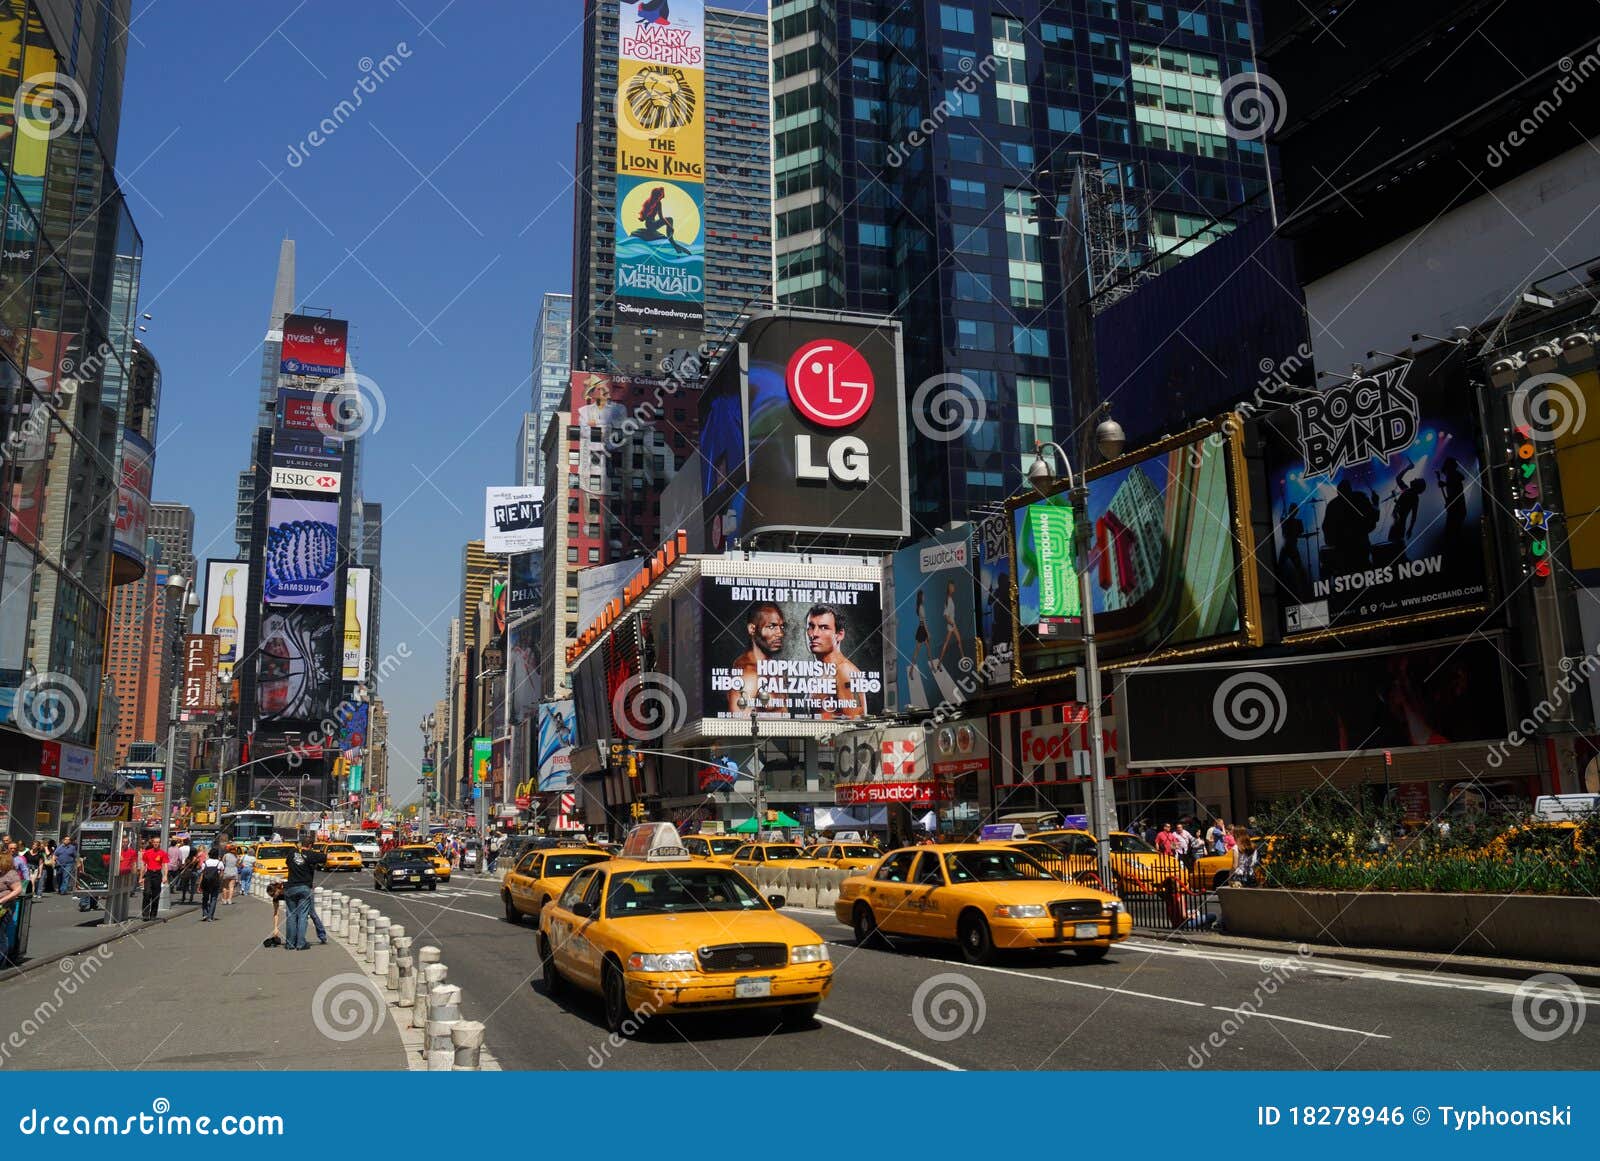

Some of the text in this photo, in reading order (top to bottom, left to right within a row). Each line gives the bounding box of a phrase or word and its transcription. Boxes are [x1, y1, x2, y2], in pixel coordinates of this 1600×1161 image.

[636, 24, 691, 47] MARY
[624, 38, 701, 64] POPPINS
[650, 138, 676, 152] THE
[621, 151, 702, 176] LION KING
[636, 264, 656, 275] THE
[658, 266, 687, 278] LITTLE
[618, 268, 702, 296] MERMAID
[302, 364, 340, 374] Prudential
[1292, 361, 1419, 440] ROCK
[1303, 408, 1417, 478] BAND
[795, 434, 870, 482] LG
[276, 472, 314, 486] HSBC
[495, 504, 542, 523] RENT
[923, 551, 957, 567] swatch
[1314, 555, 1442, 597] IN STORES NOW
[278, 582, 322, 593] SAMSUNG
[716, 578, 734, 586] PLANET
[736, 578, 769, 586] HOLLYWOOD
[797, 580, 817, 588] CASINO
[830, 582, 847, 590] VEGAS
[848, 583, 874, 592] PRESENTS
[732, 587, 858, 605] BATTLE OF THE PLANET
[1401, 585, 1484, 607] WWW.ROCKBAND.COM
[757, 660, 837, 677] HOPKINS VS
[712, 676, 745, 691] HBO
[758, 678, 837, 694] CALZAGHE
[850, 679, 882, 693] HBO
[796, 700, 804, 708] IN
[806, 700, 821, 708] THE
[1022, 727, 1073, 762] Foot
[868, 785, 924, 800] swatch
